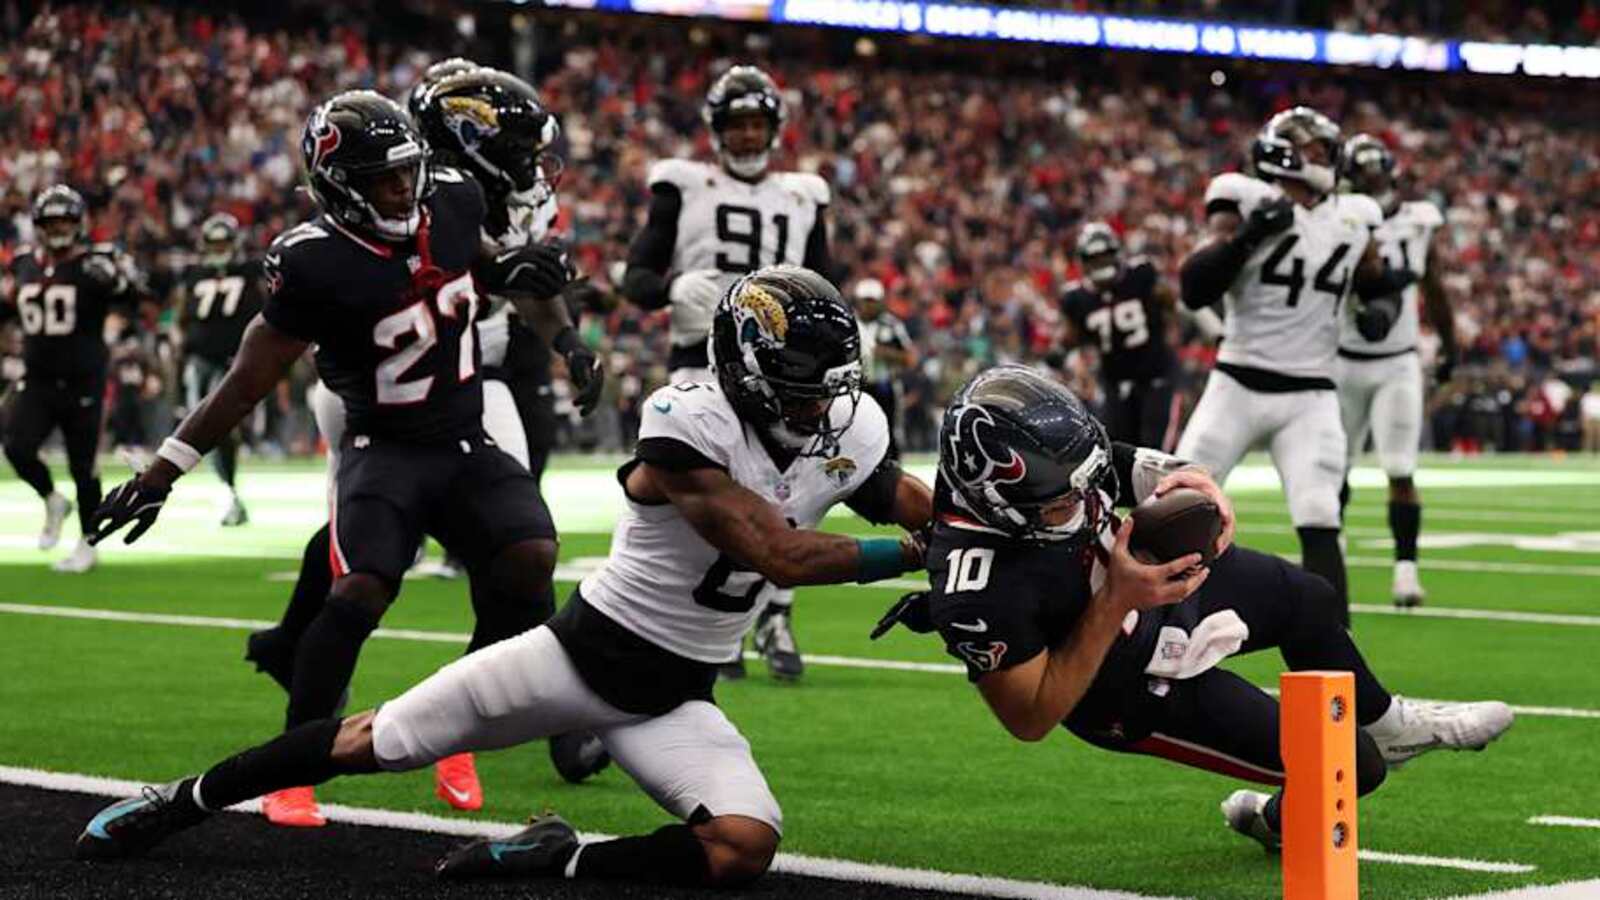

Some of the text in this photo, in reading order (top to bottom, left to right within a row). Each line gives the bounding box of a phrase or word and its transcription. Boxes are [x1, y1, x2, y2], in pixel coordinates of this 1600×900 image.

[716, 204, 788, 275] 91
[194, 275, 245, 320] 77
[1260, 234, 1350, 317] 44
[17, 283, 77, 335] 60
[1086, 298, 1149, 353] 79
[373, 270, 479, 404] 27
[944, 547, 995, 594] 10
